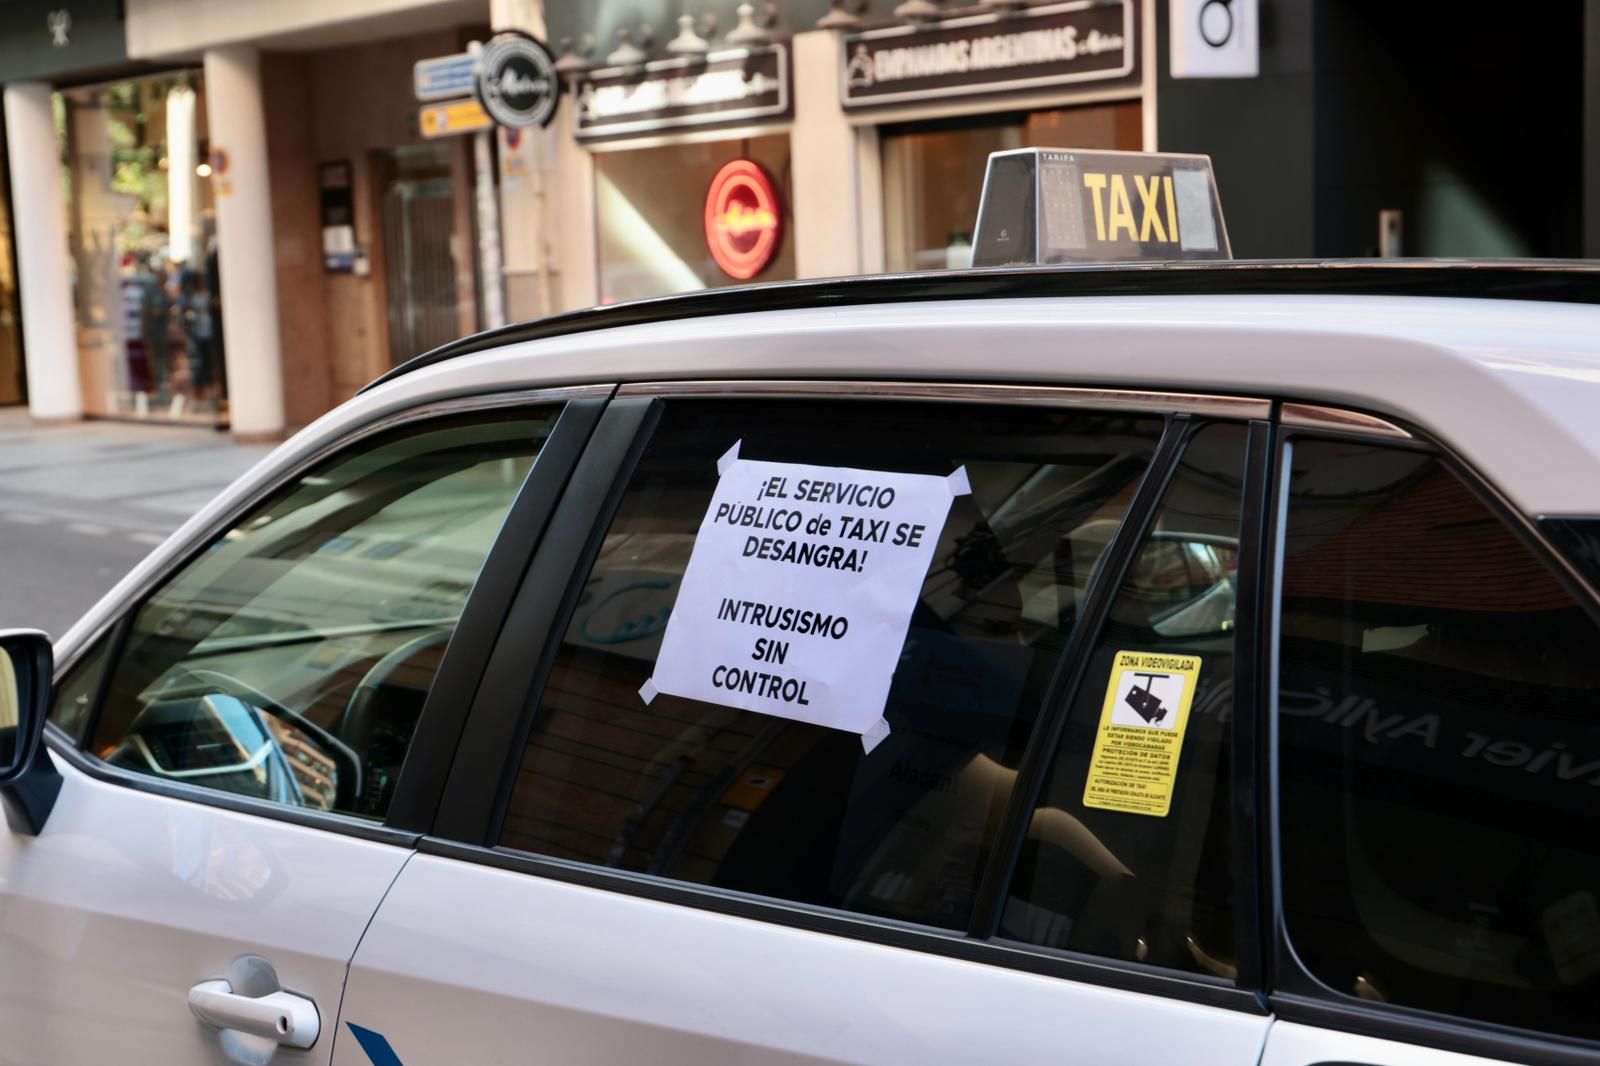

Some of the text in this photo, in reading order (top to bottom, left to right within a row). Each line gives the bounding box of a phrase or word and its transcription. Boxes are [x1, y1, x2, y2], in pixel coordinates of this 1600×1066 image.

[1042, 153, 1076, 162] TARIFA
[1083, 172, 1179, 243] TAXI
[757, 477, 895, 509] ¡EL SERVICIO
[714, 502, 926, 547] PÚBLICO de TAXI SE
[743, 536, 868, 573] DESANGRA!
[717, 598, 848, 639] INTRUSISMO
[752, 638, 789, 665] SIN
[1120, 655, 1195, 670] ZONA VIDEOVIGILADA
[712, 665, 810, 706] CONTROL
